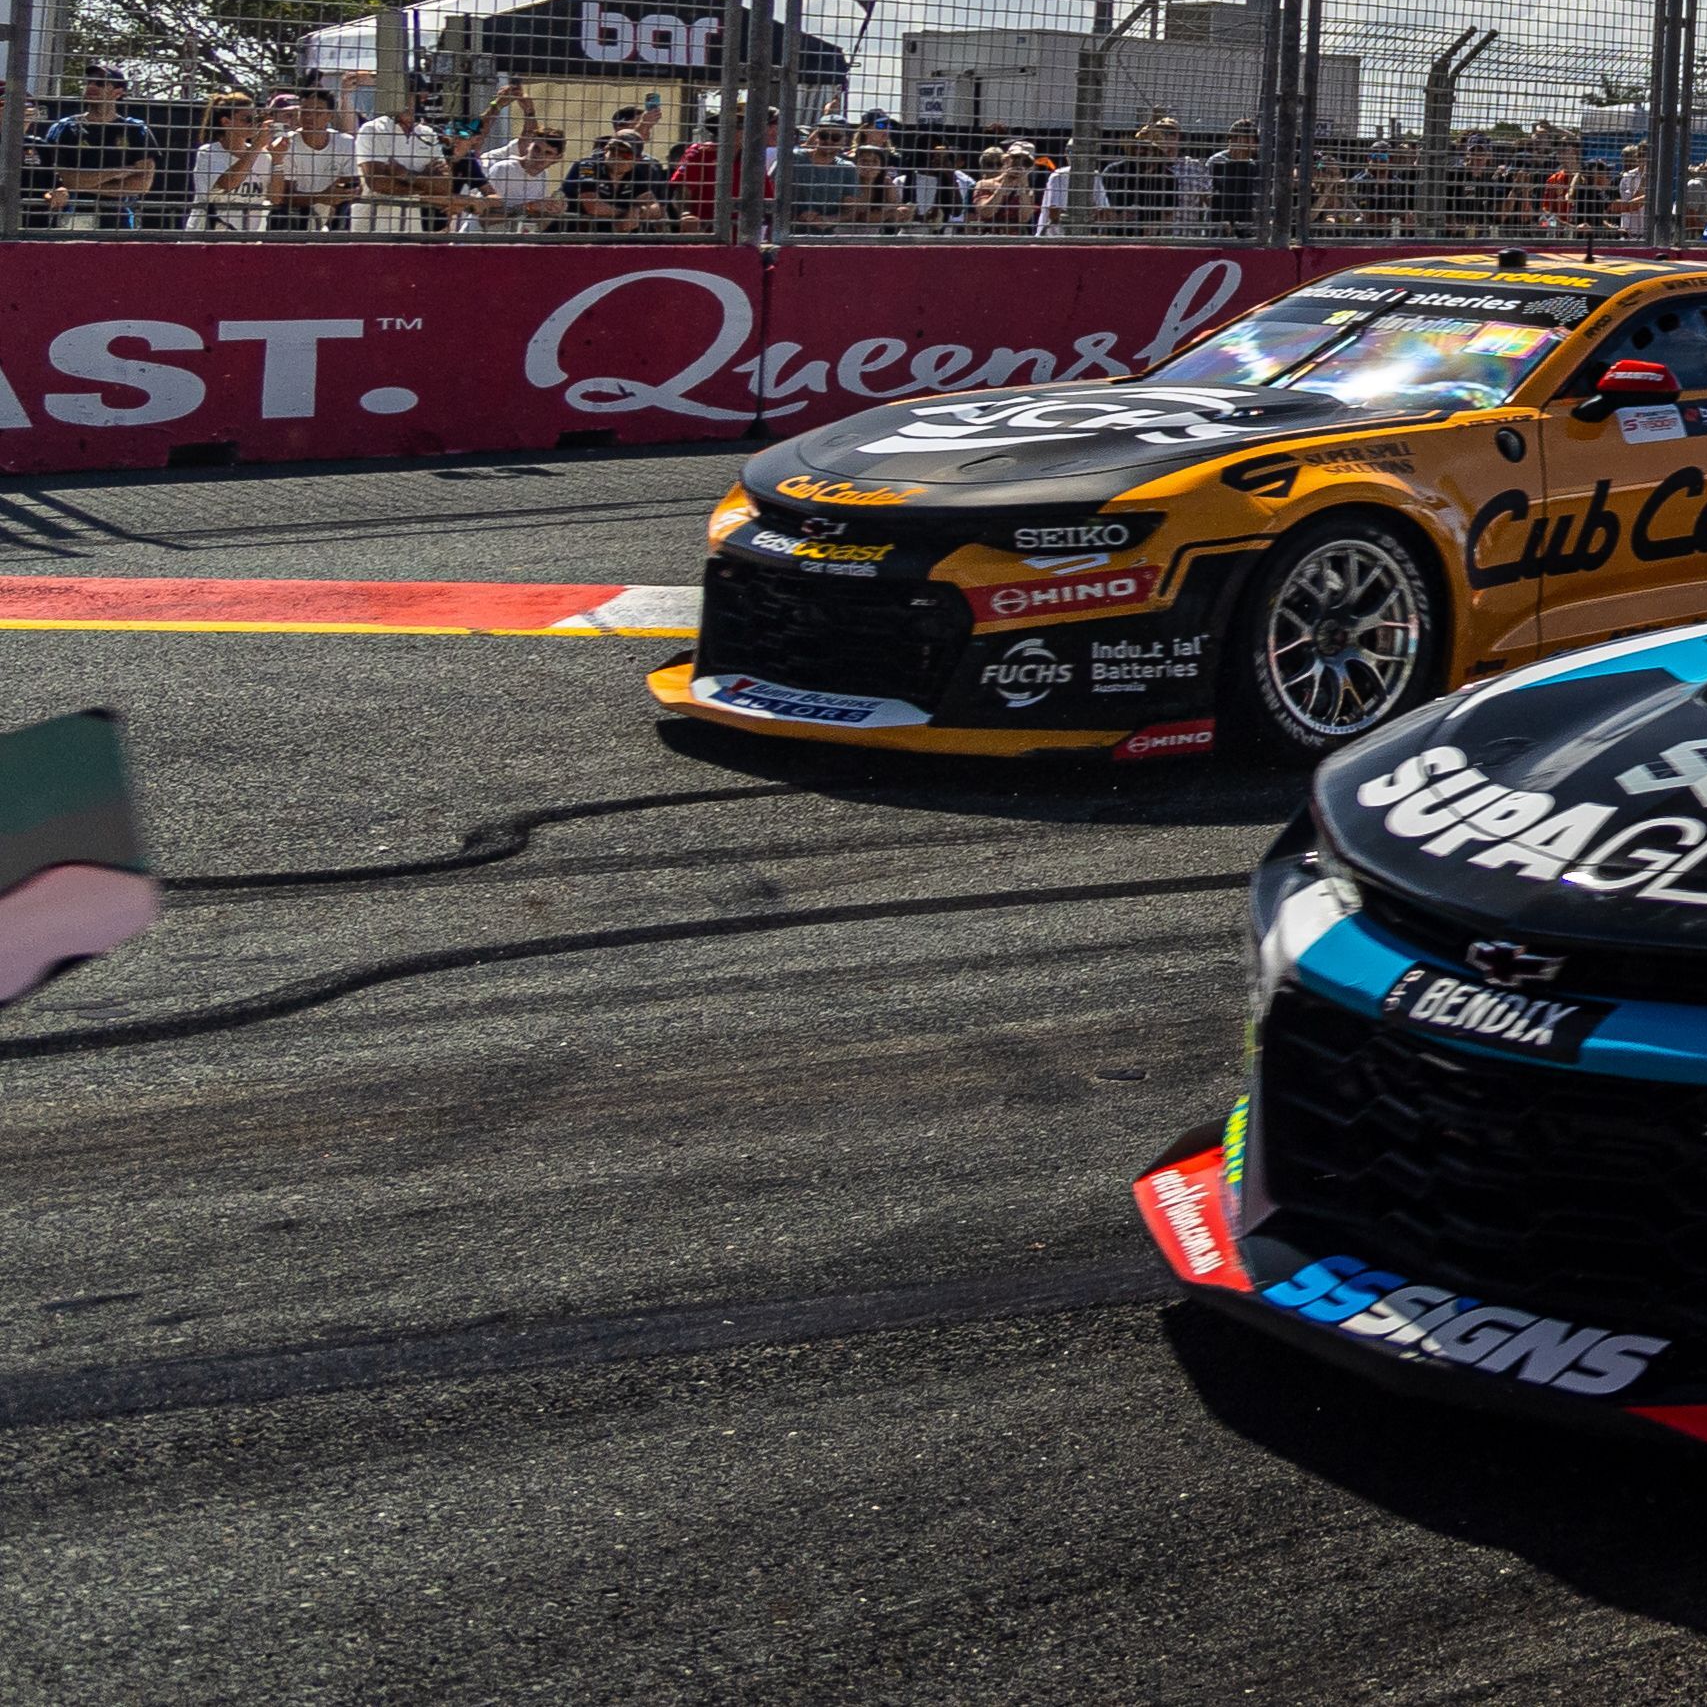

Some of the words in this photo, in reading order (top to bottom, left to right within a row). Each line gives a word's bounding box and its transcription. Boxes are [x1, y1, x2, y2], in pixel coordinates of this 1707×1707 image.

[581, 1, 720, 66] bar
[1387, 289, 1523, 312] atteries
[1013, 523, 1130, 549] SEIKO
[1466, 478, 1621, 591] Cub
[1030, 577, 1138, 606] HINO
[980, 663, 1076, 685] FUCHS
[1090, 659, 1199, 680] Batteries
[1151, 731, 1214, 748] HINO
[1408, 977, 1581, 1046] BENDIX
